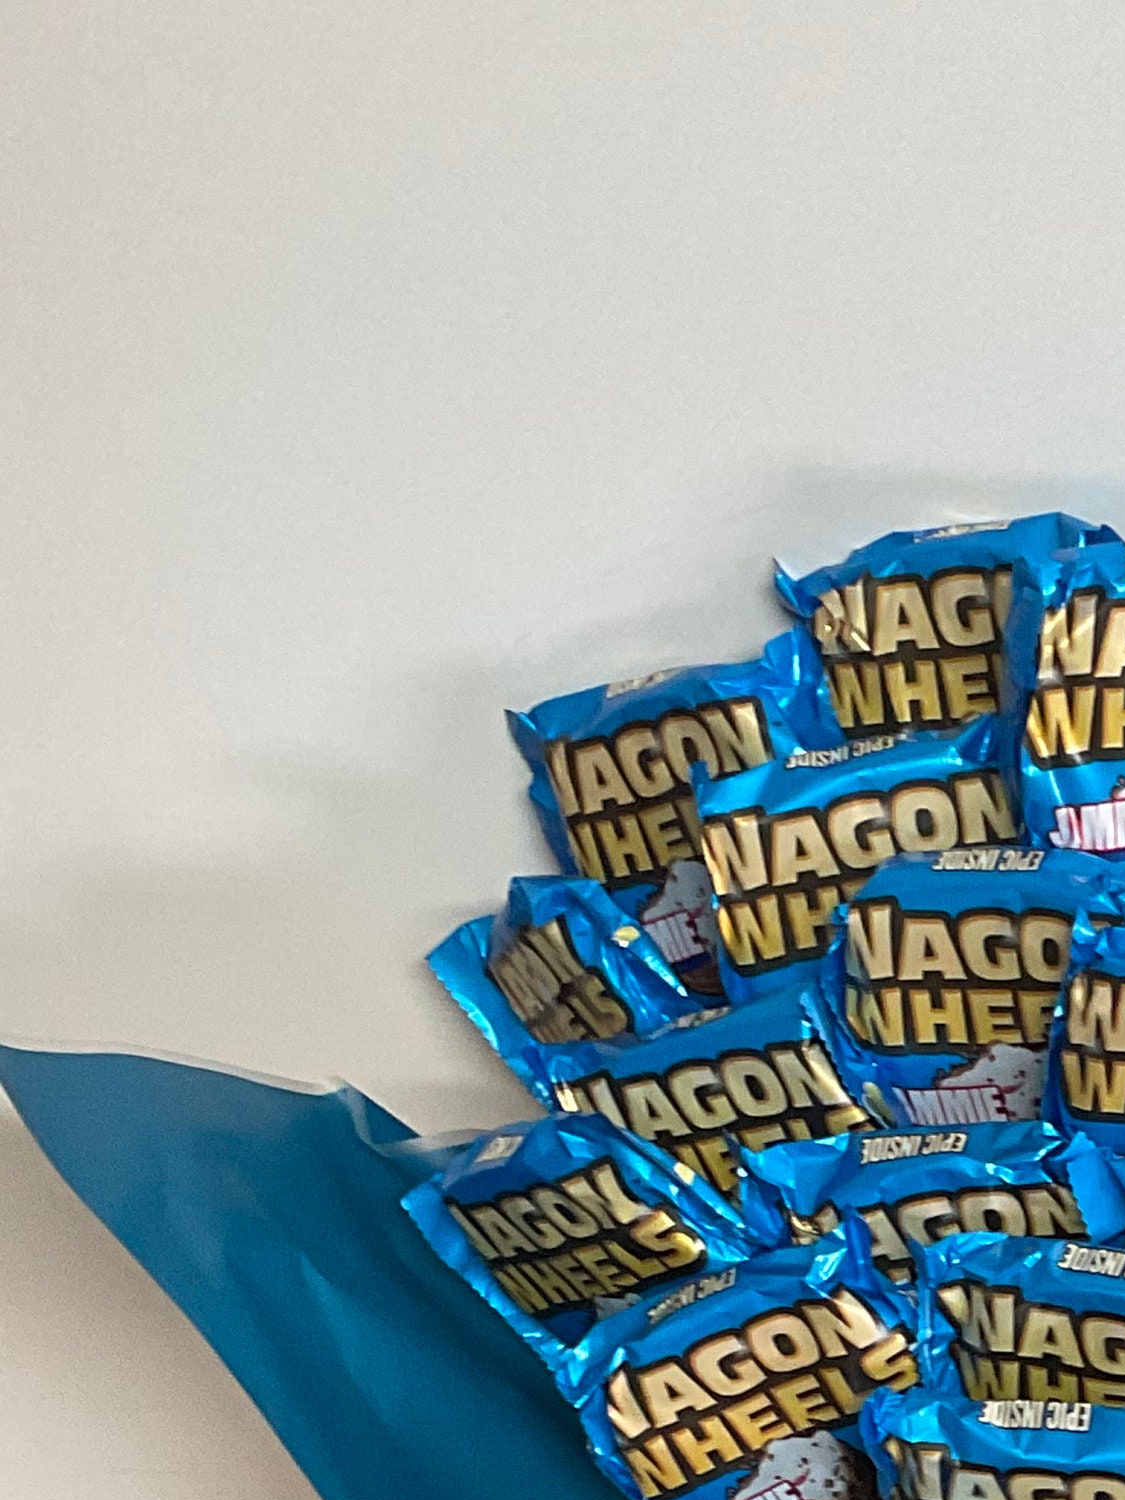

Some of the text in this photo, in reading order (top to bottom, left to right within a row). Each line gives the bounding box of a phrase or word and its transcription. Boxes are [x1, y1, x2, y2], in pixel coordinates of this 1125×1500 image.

[828, 652, 1003, 729] WHE
[845, 903, 1074, 982] WAGO
[922, 1133, 967, 1153] EPIC
[1047, 1402, 1092, 1431] EPIC
